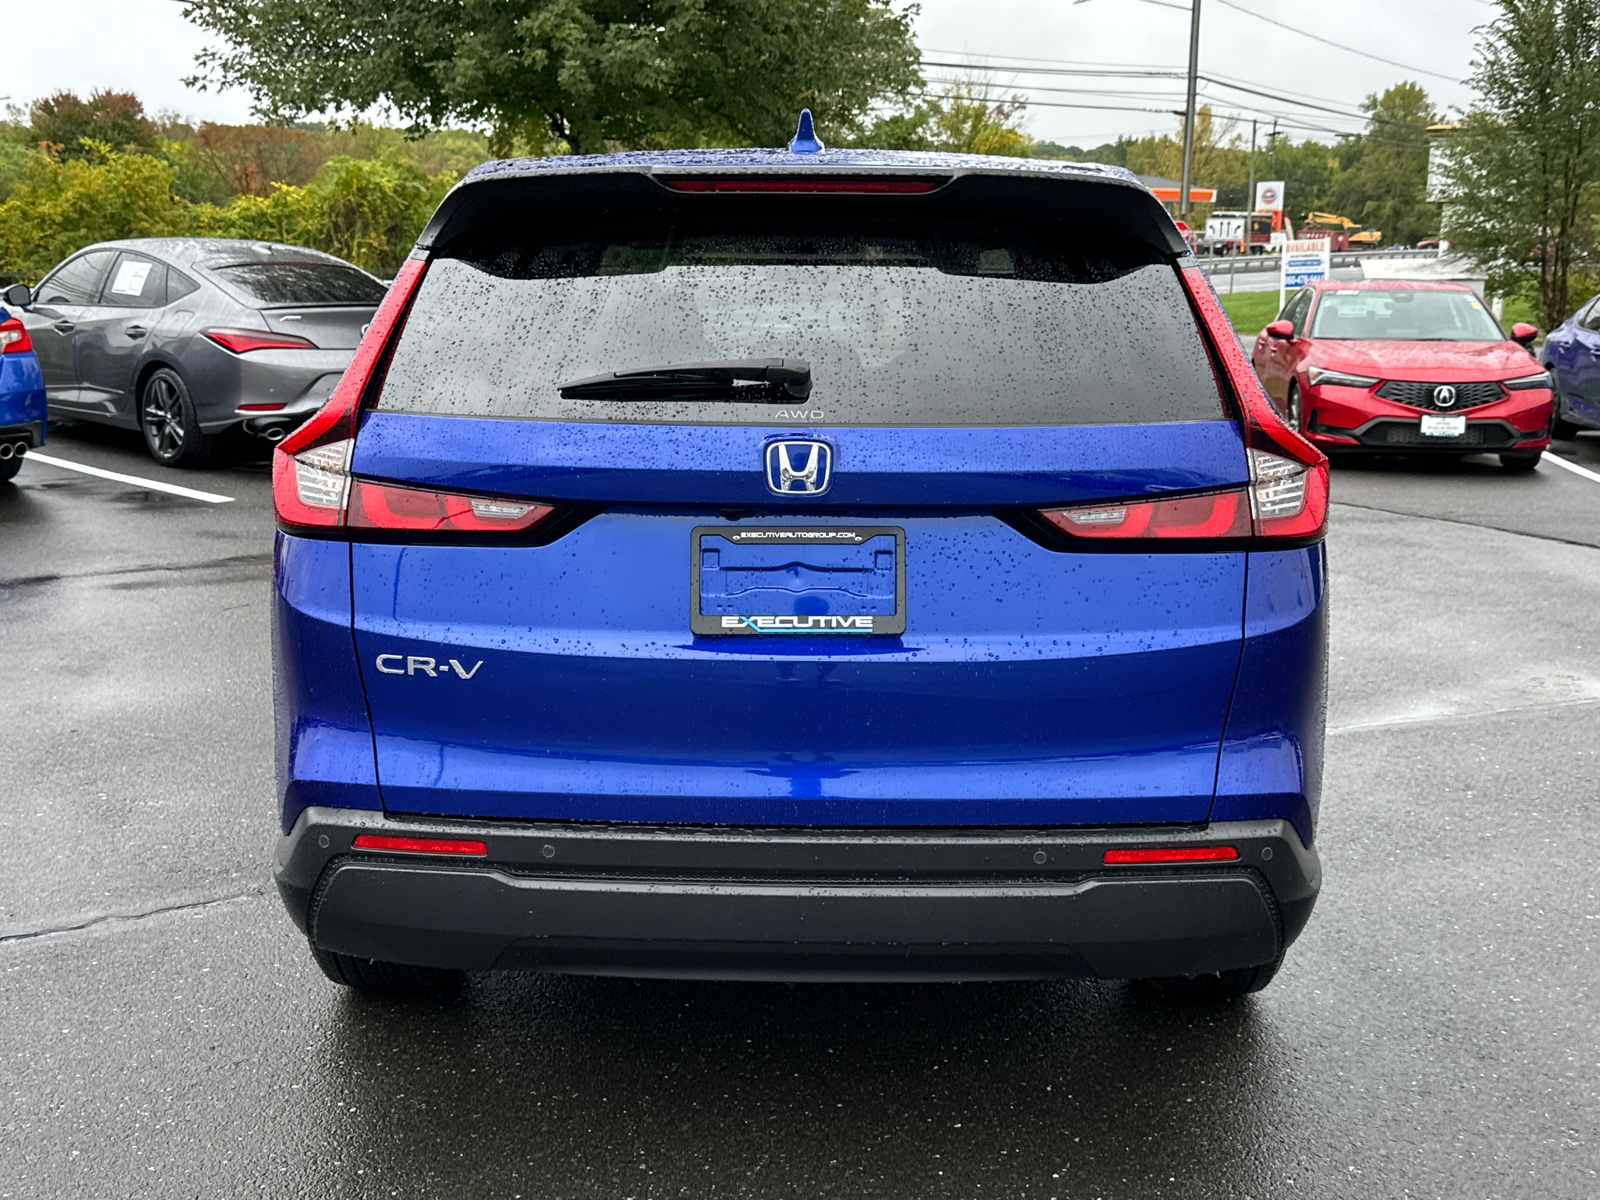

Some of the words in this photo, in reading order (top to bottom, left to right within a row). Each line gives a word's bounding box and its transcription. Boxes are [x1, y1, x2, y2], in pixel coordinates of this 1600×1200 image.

[1286, 241, 1324, 252] AVAILABLE
[774, 409, 825, 419] AWD
[721, 615, 874, 629] EXECUTIVE
[375, 653, 485, 680] CR-V
